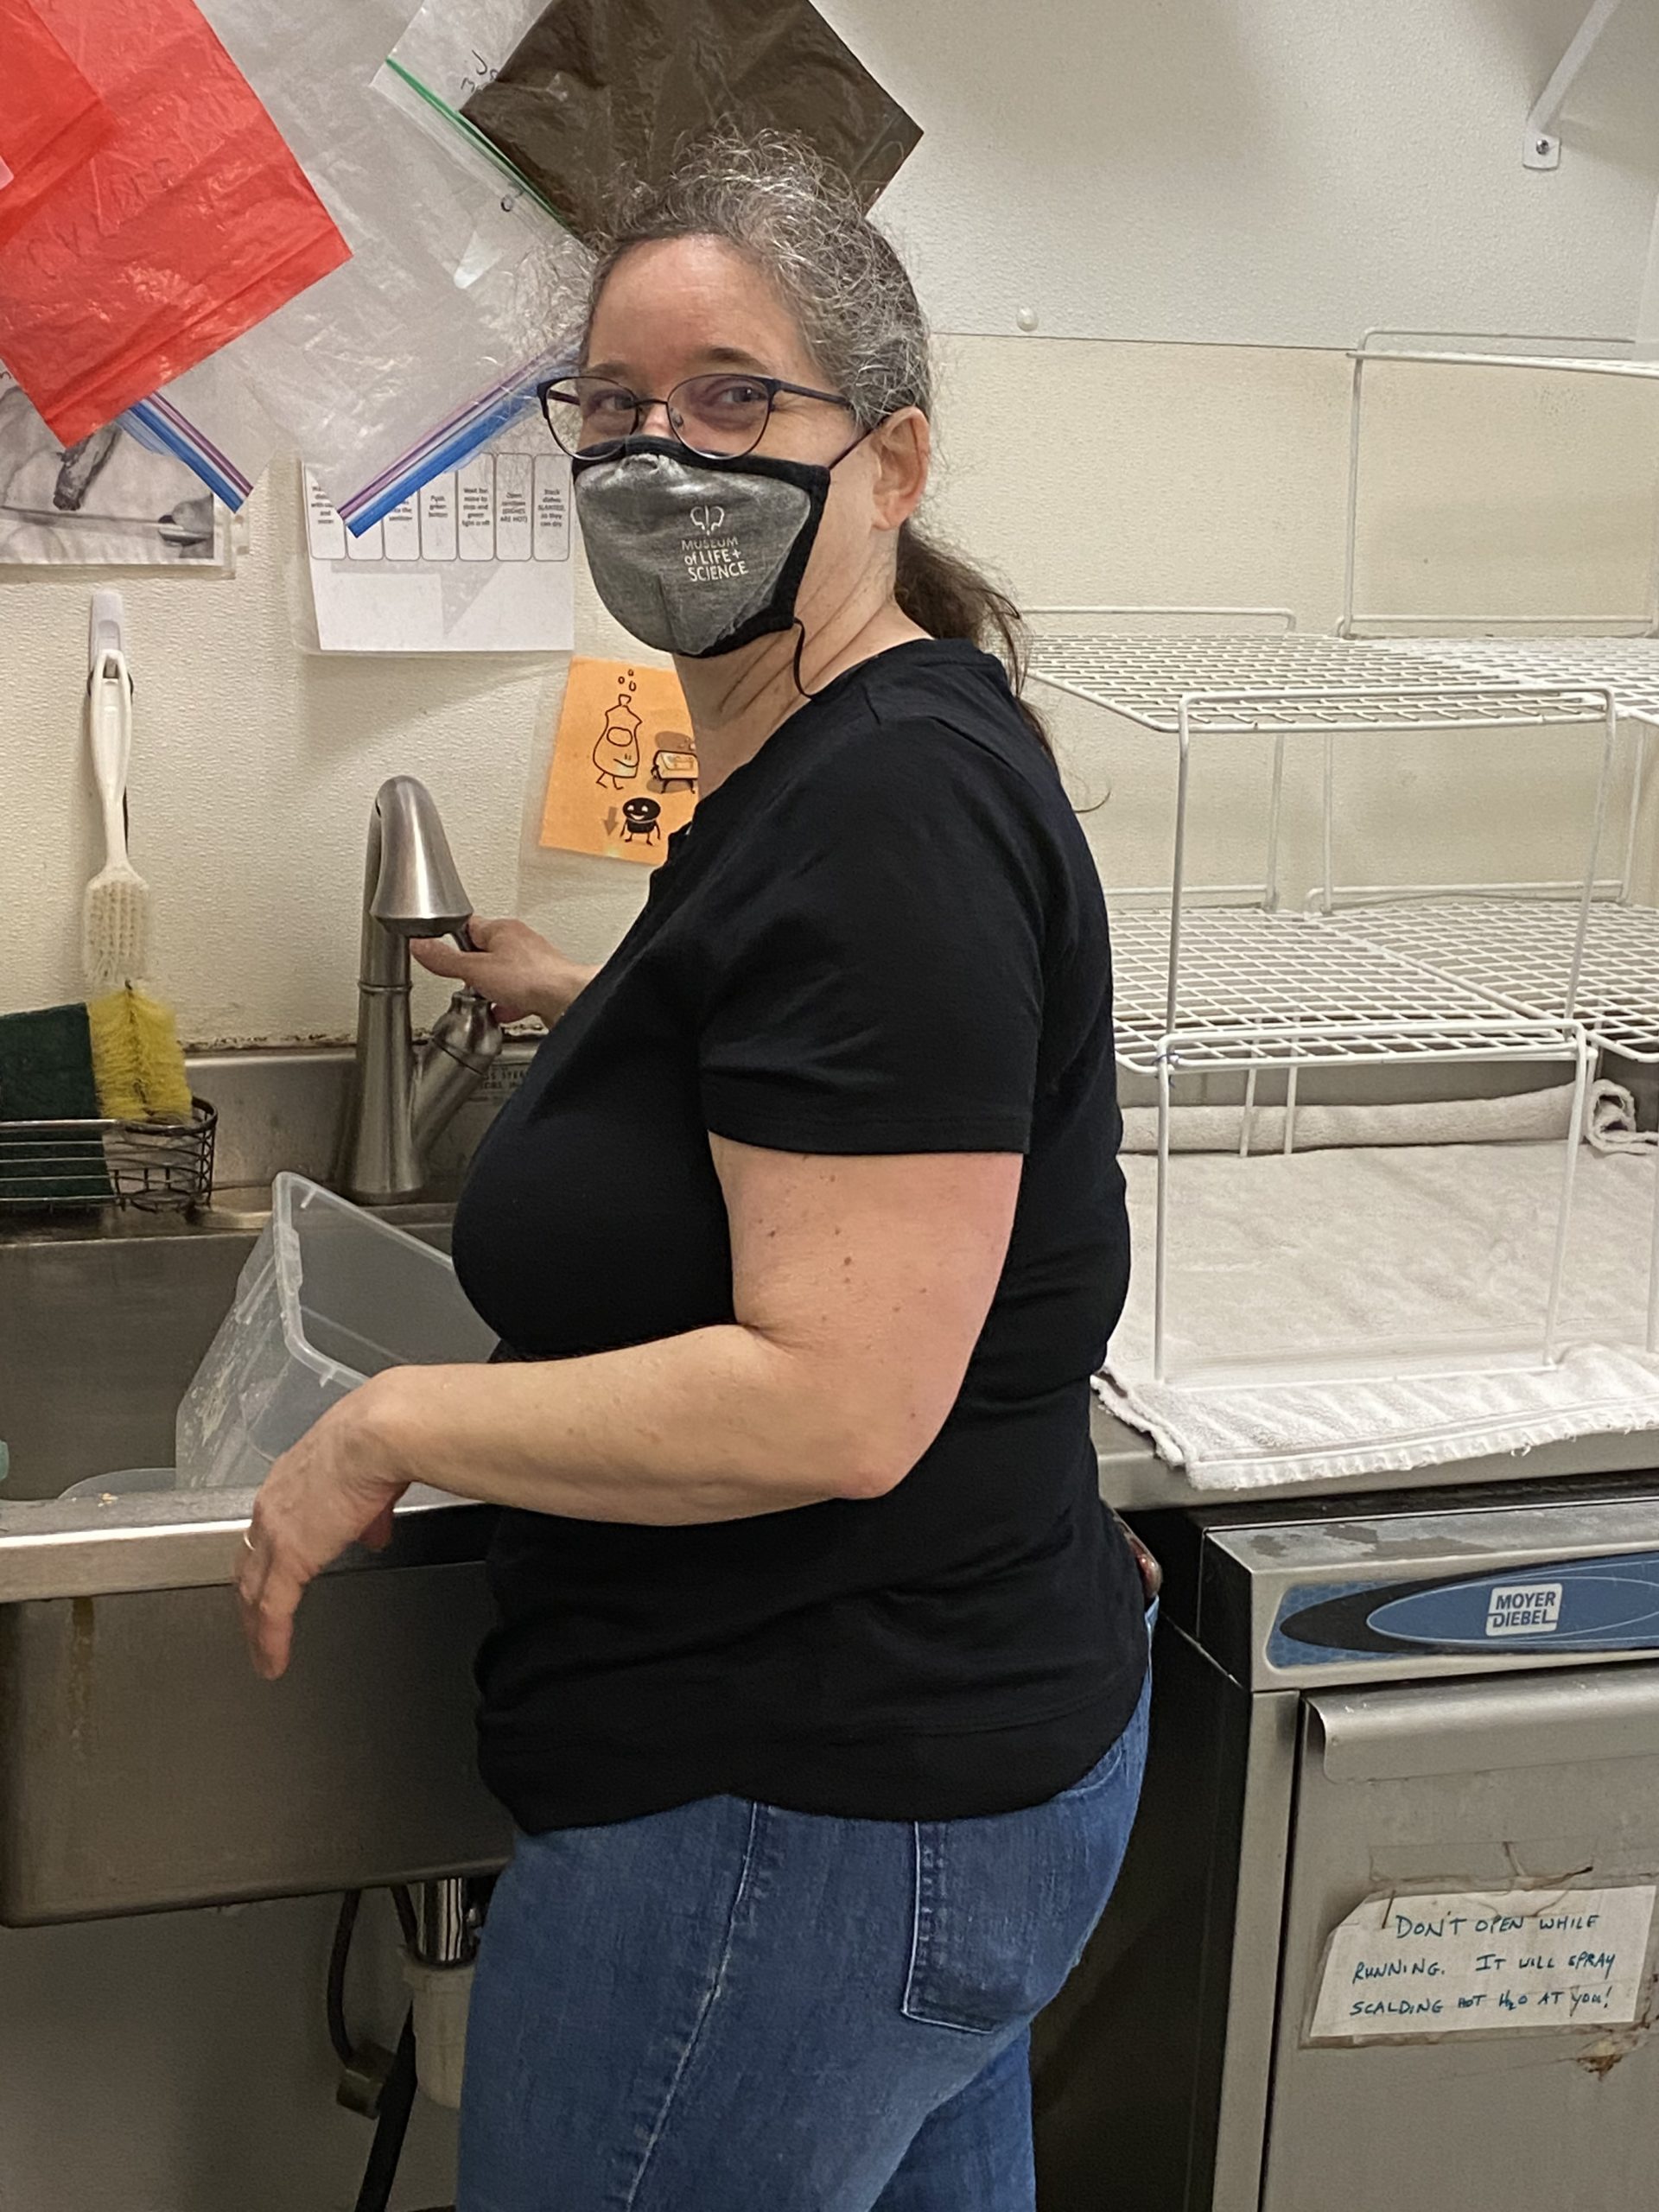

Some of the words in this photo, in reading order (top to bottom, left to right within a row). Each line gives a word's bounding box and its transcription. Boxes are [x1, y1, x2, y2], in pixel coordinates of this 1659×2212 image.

[681, 536, 739, 550] MUSEUM
[699, 549, 731, 564] LIFE
[688, 560, 748, 582] SCIENCE
[1496, 1592, 1556, 1610] MOYER
[1488, 1609, 1556, 1628] DIEBEL
[1395, 1910, 1467, 1938] DON'T
[1474, 1914, 1524, 1935] OPEN
[1539, 1914, 1600, 1930] WHILE
[1351, 1961, 1446, 1984] RUNNING.
[1517, 1955, 1555, 1970] WILL
[1567, 1951, 1617, 1980] SPRAY
[1349, 1999, 1445, 2016] SCALDING
[1458, 1994, 1487, 2009] HOT
[1537, 1991, 1564, 2005] AT
